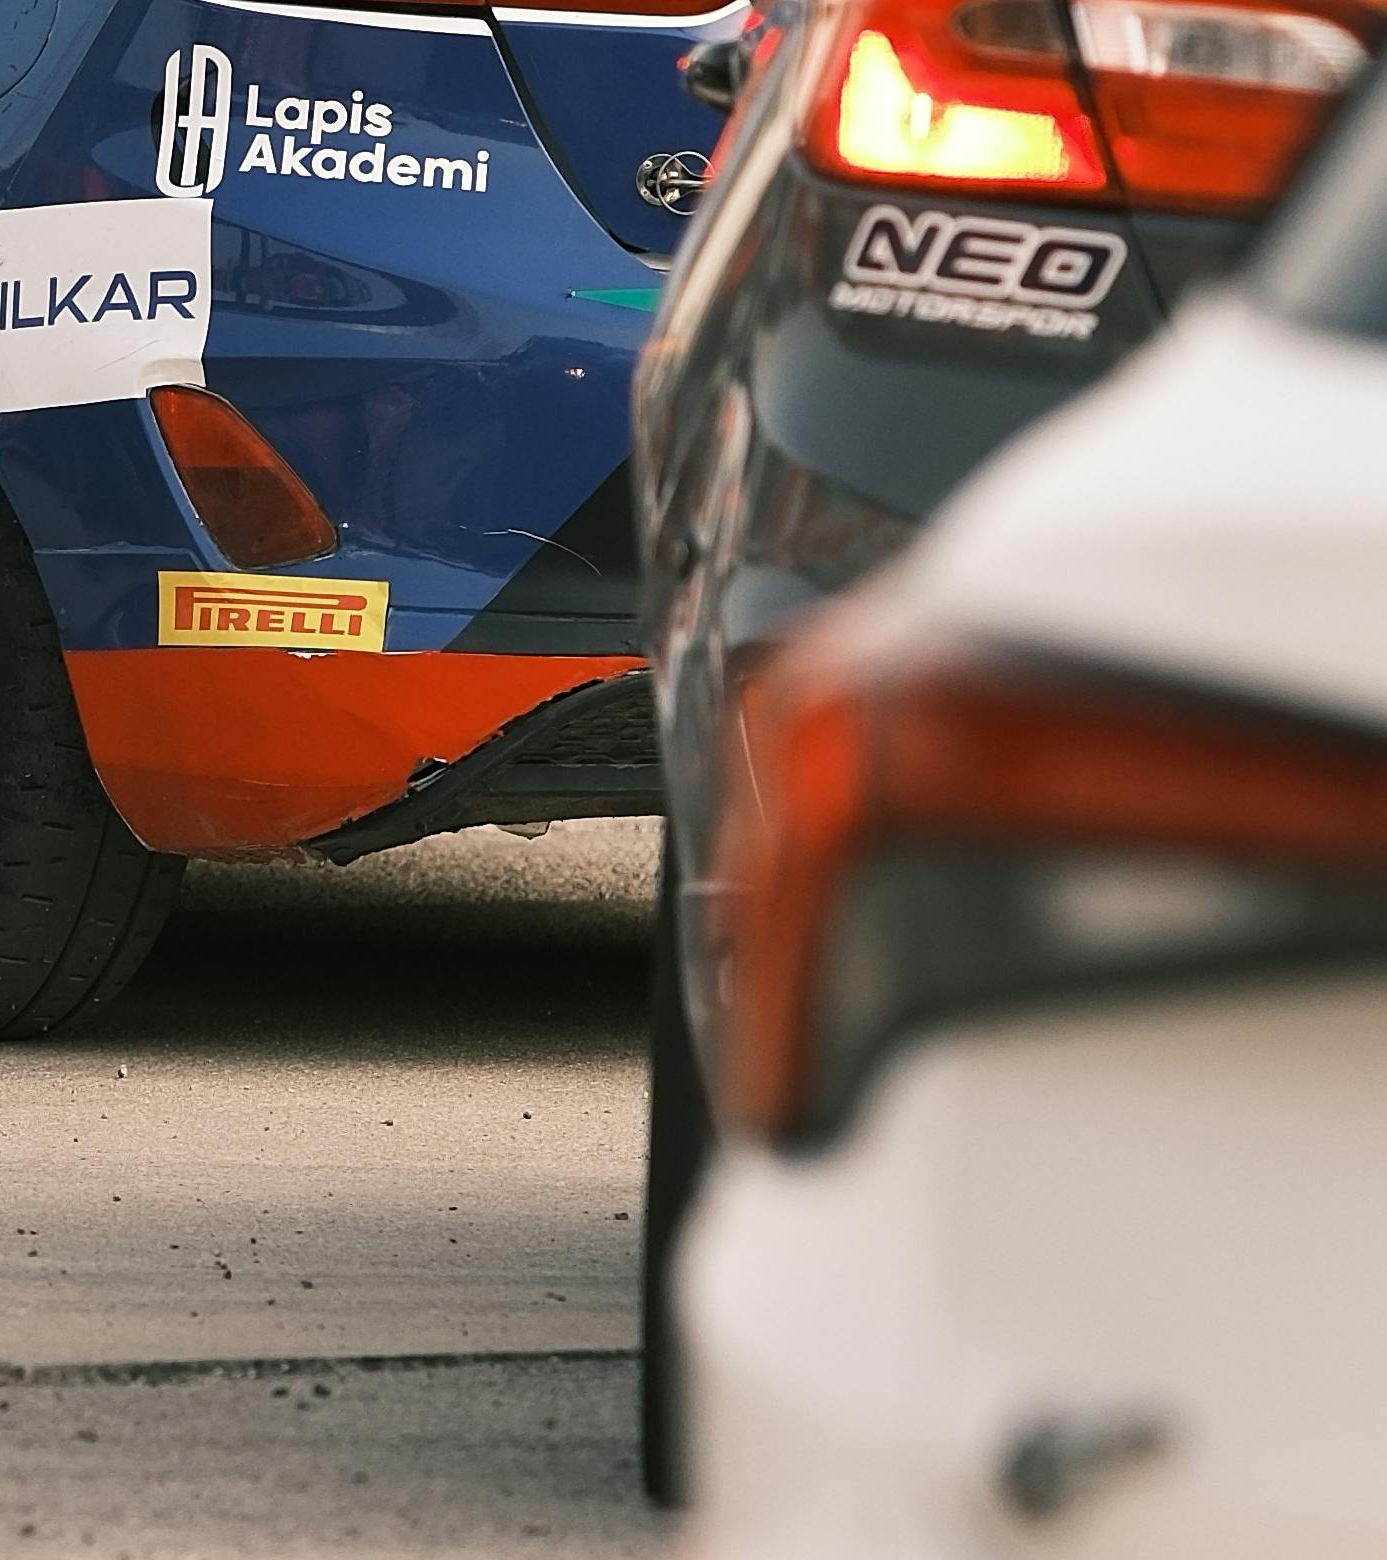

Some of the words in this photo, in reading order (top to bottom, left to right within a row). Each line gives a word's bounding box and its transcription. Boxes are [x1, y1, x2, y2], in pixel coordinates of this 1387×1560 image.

[244, 83, 394, 145] Lapis
[238, 132, 491, 194] Akademi
[849, 211, 1121, 304] NEO
[174, 586, 368, 637] PIRELLI
